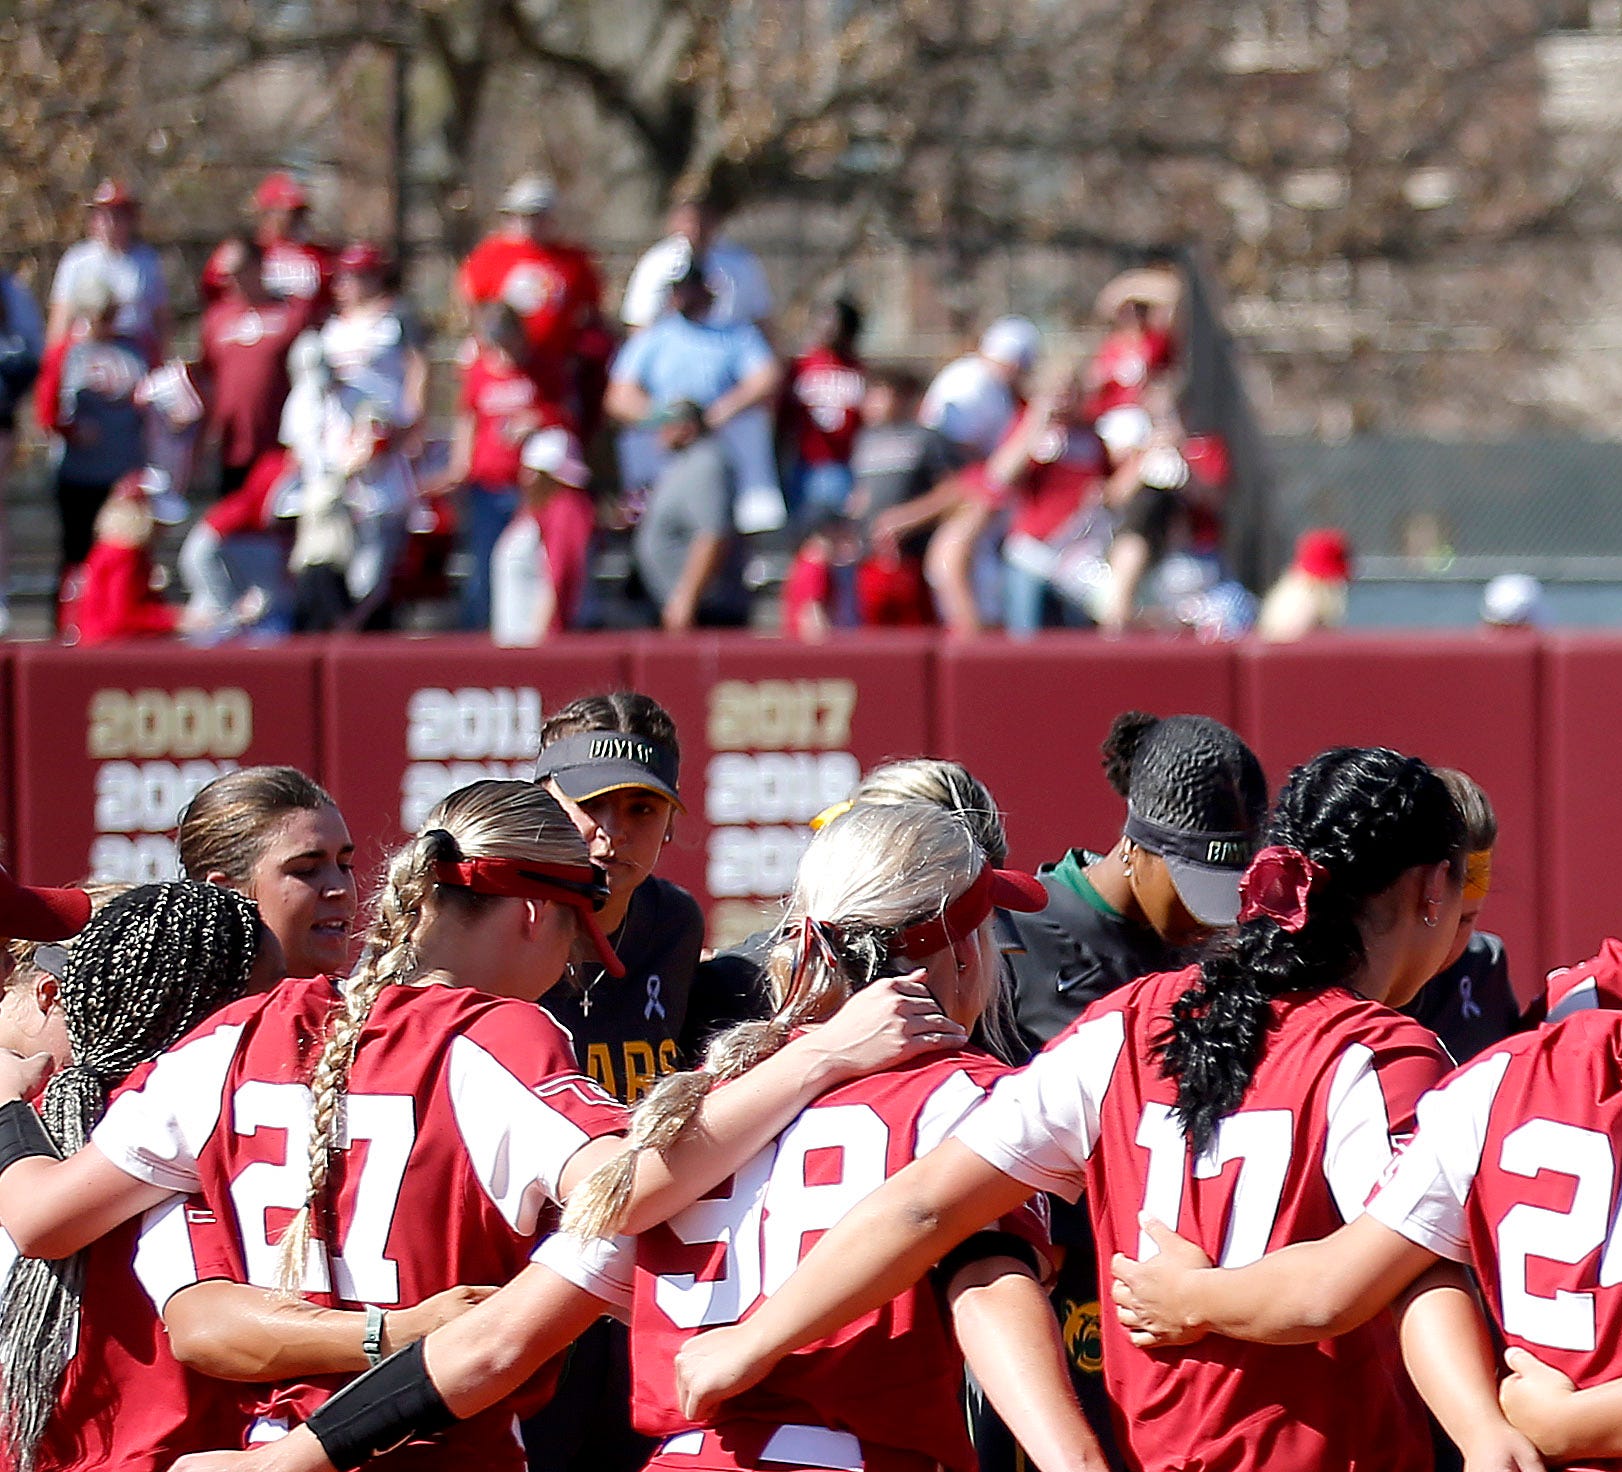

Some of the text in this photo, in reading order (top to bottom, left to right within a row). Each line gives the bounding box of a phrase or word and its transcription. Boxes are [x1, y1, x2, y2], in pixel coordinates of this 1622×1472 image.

[88, 687, 255, 759] 2000
[587, 1039, 677, 1105] ARS
[230, 1081, 417, 1304] 27
[1135, 1103, 1294, 1269] 17
